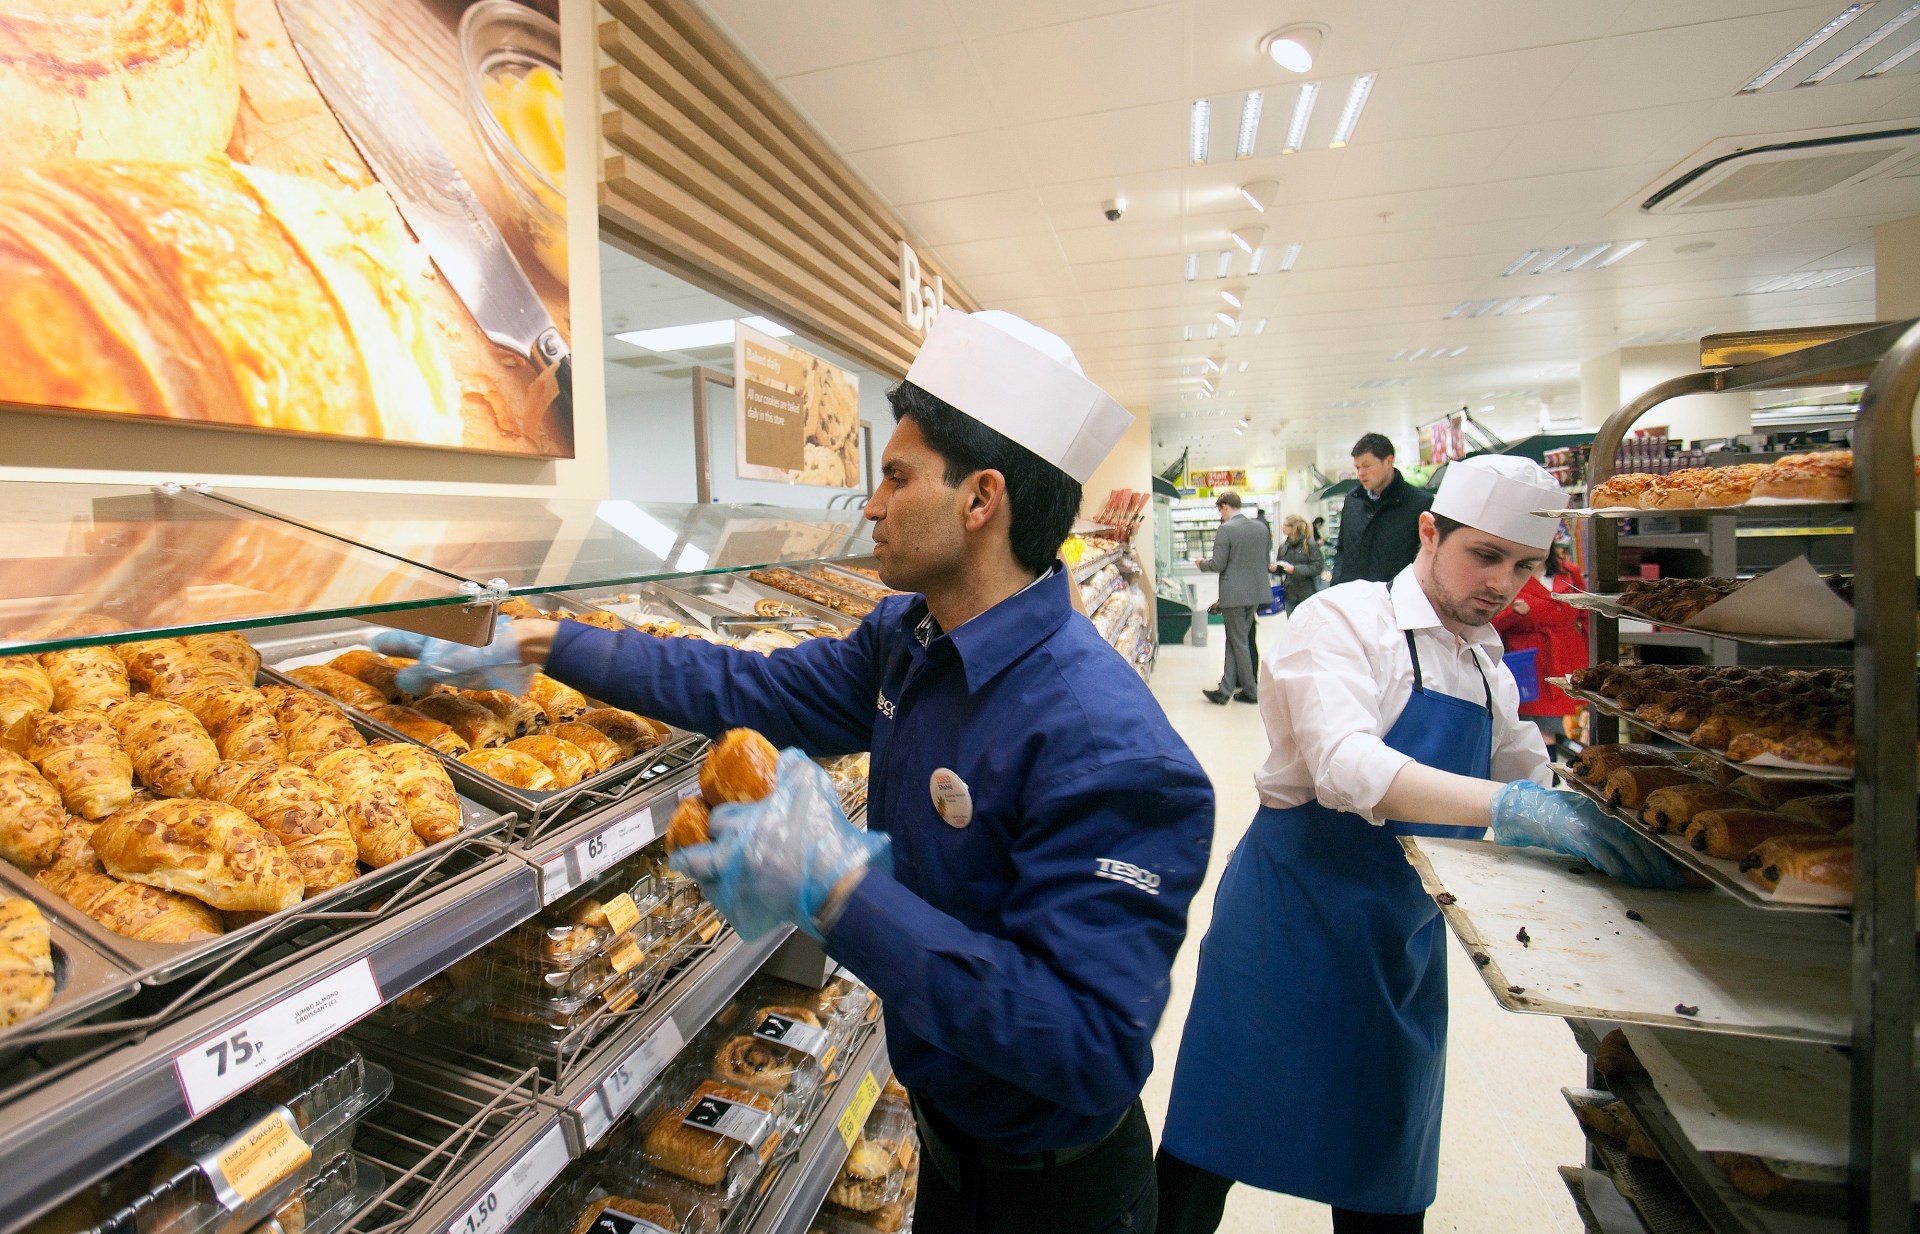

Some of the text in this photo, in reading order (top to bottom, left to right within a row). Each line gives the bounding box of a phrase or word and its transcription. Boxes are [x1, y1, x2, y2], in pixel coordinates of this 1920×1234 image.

[747, 388, 755, 400] All
[755, 393, 763, 403] our
[763, 395, 780, 408] cookies
[787, 401, 800, 414] baked
[747, 407, 759, 422] daily
[764, 410, 774, 423] this
[1208, 479, 1230, 487] Price
[1210, 471, 1228, 480] Half
[1095, 857, 1161, 888] TESCO
[294, 990, 339, 1018] JUMBO ALMOND
[295, 998, 337, 1024] CROISSANT (C)
[223, 1145, 246, 1166] TESCO
[249, 1117, 283, 1146] Bakery
